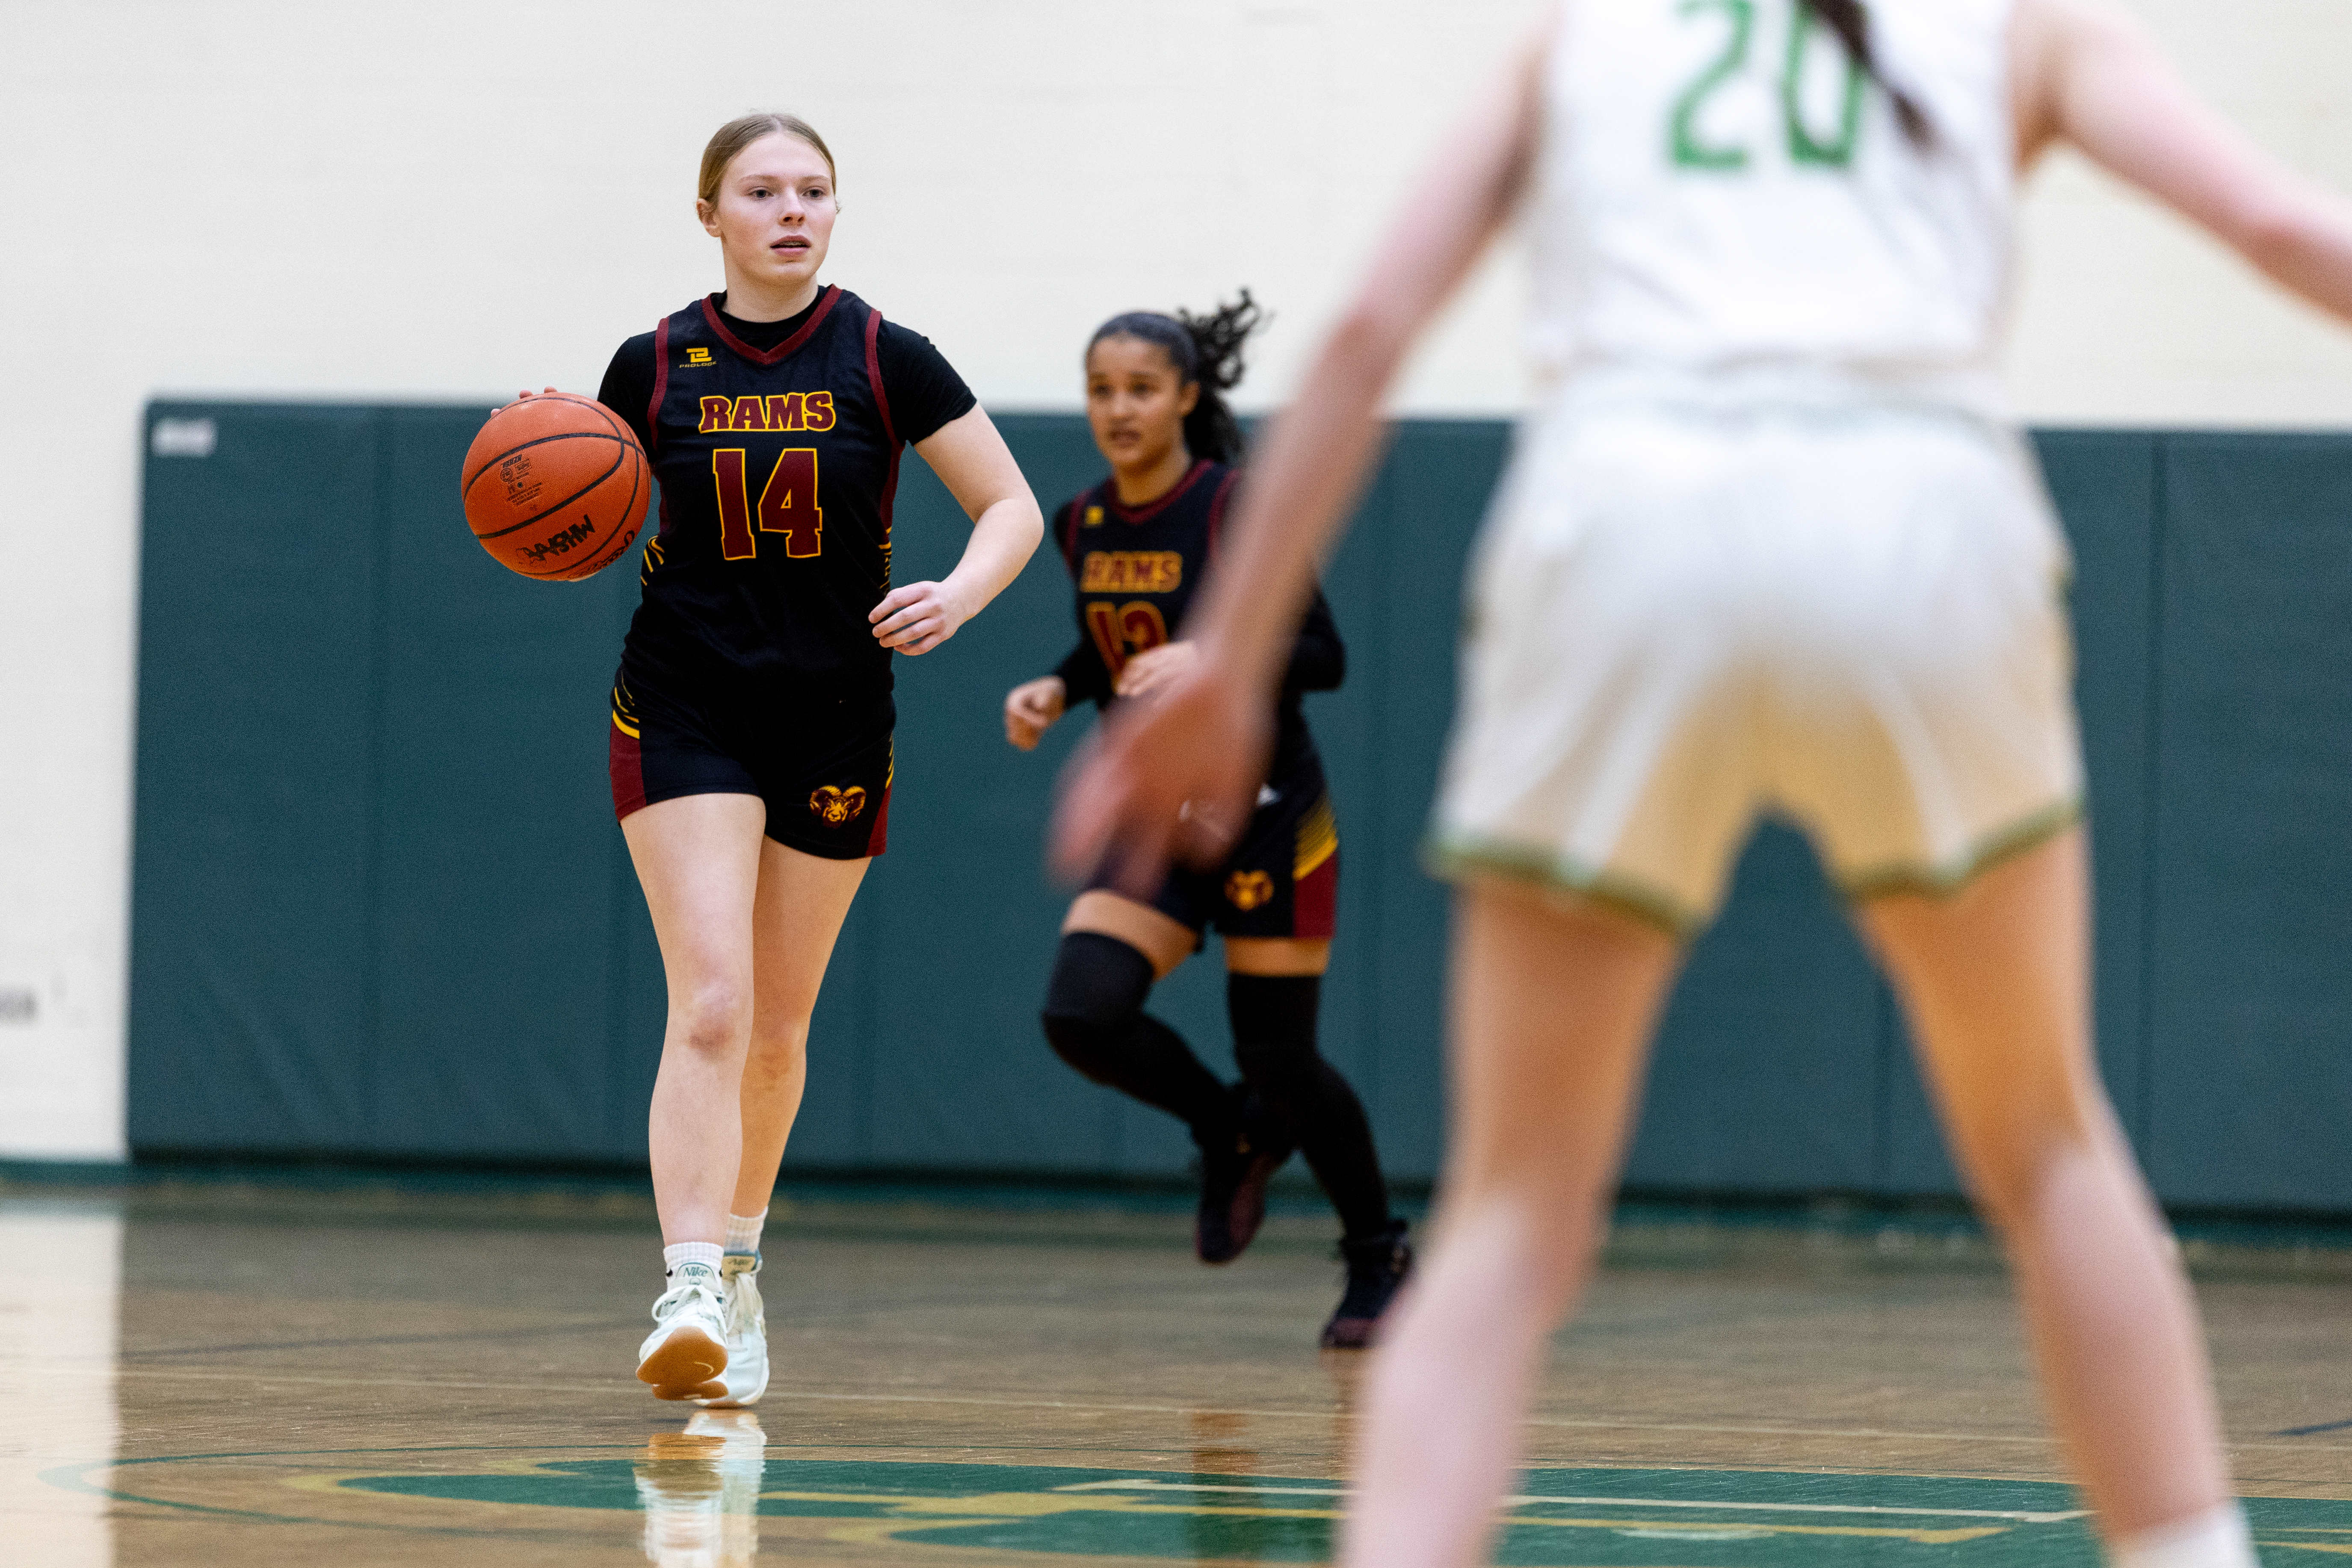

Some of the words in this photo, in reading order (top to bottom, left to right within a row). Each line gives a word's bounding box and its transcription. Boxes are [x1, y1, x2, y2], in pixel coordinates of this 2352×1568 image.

[1668, 0, 1867, 169] 20
[698, 391, 836, 433] RAMS
[713, 448, 822, 560] 14
[1080, 550, 1183, 593] RAMS
[683, 1266, 708, 1277] Nike
